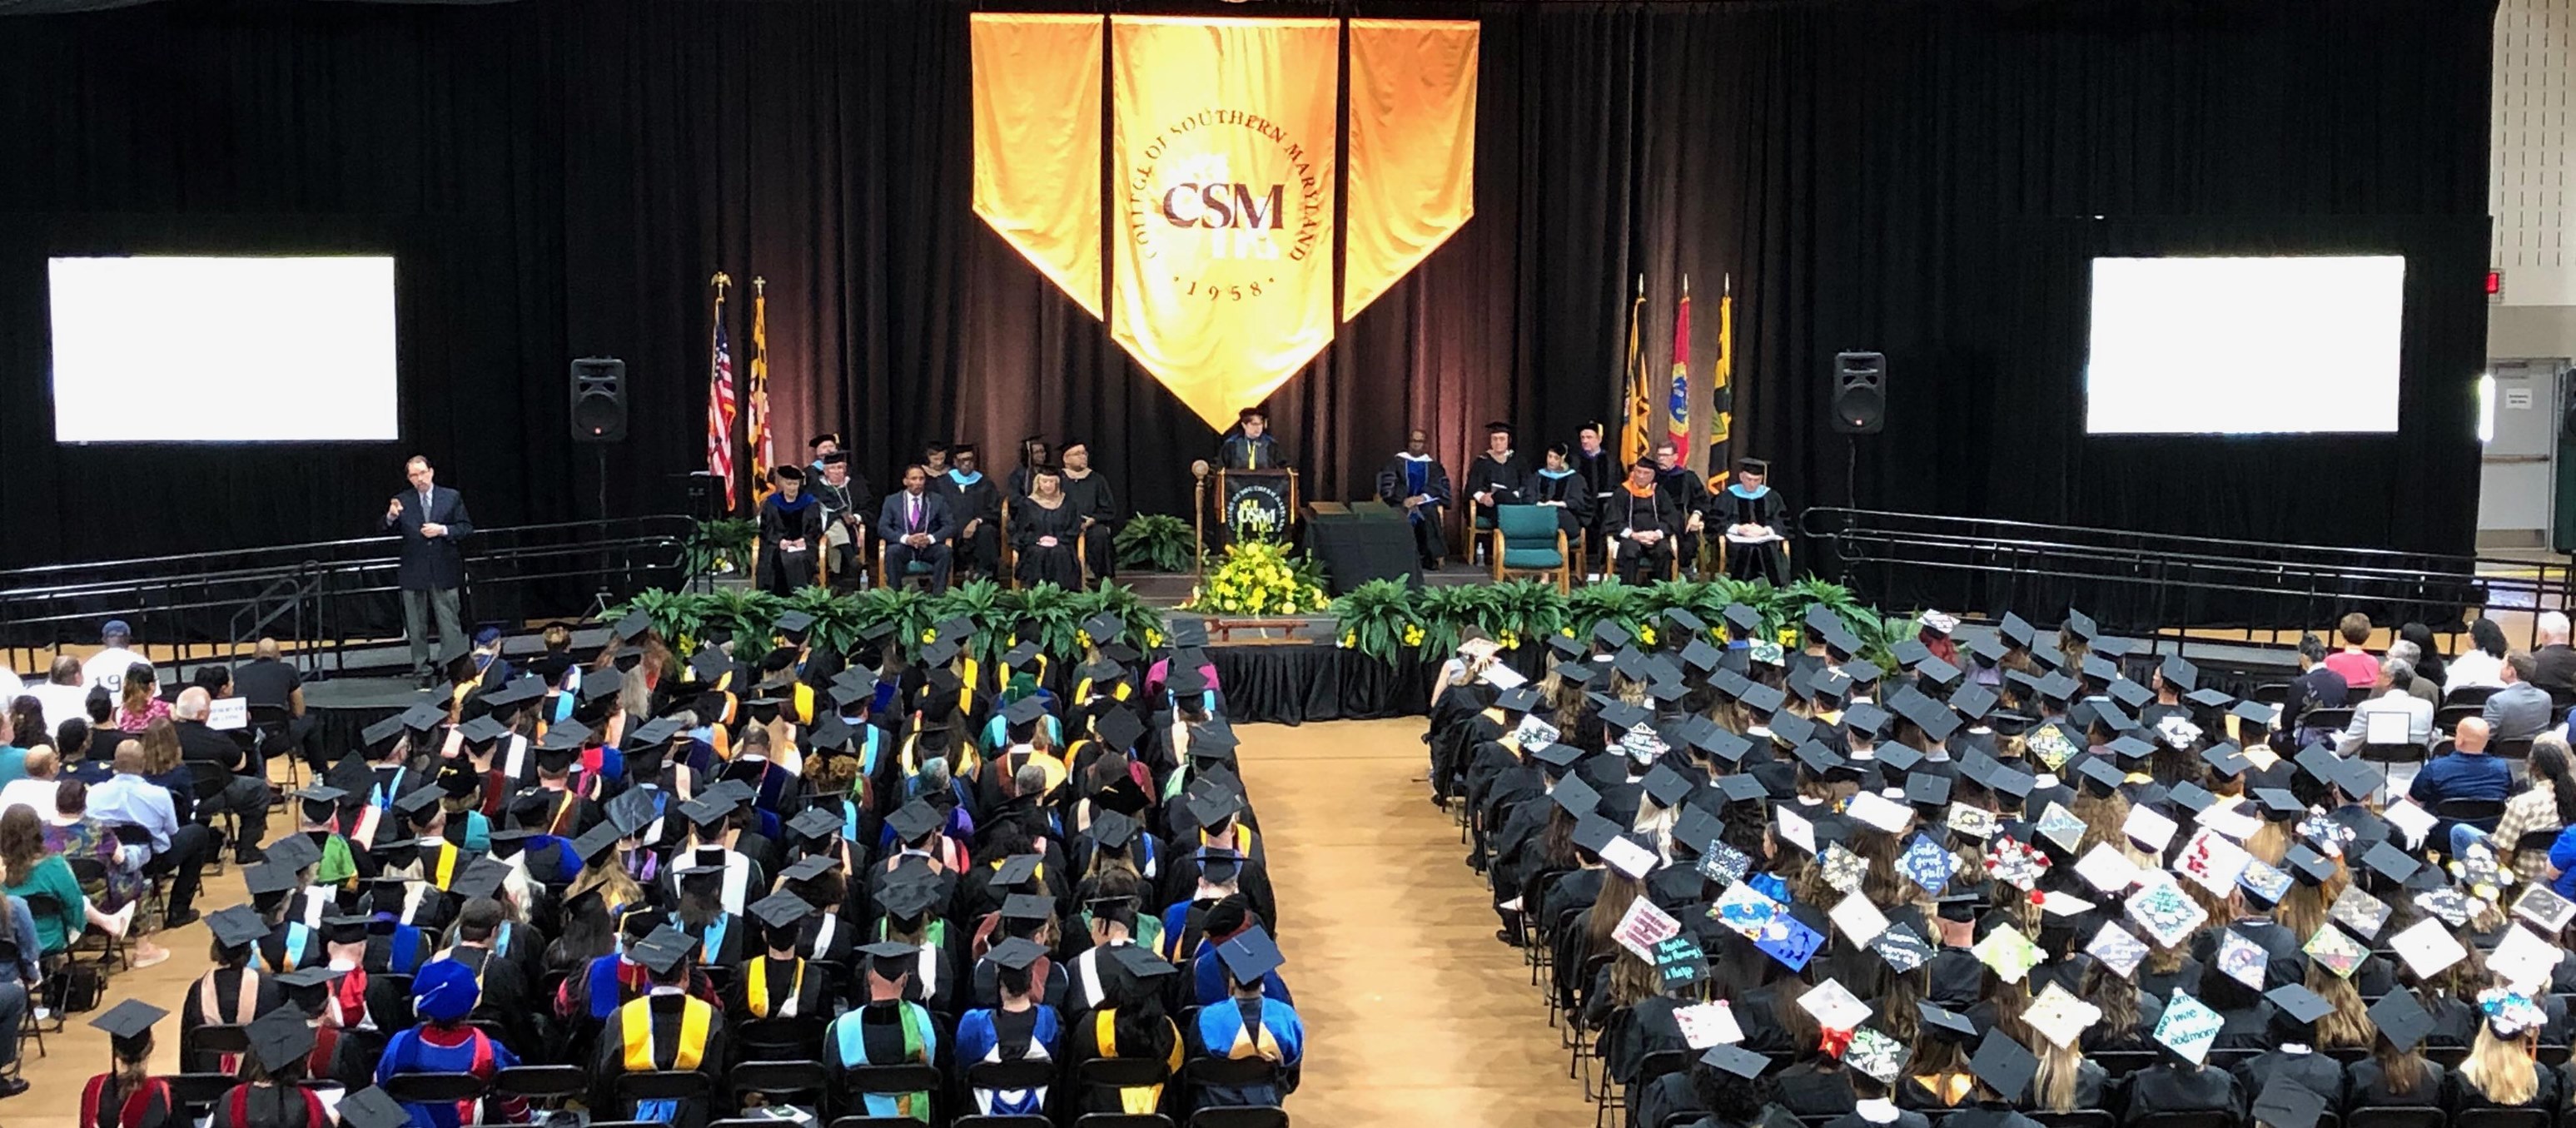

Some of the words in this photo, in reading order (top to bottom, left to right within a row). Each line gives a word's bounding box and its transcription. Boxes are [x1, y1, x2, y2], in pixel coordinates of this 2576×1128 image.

[1162, 182, 1285, 230] CSM
[1170, 109, 1287, 143] SOUTHERN
[1284, 142, 1320, 261] MARYLAND
[1187, 281, 1262, 301] 1958
